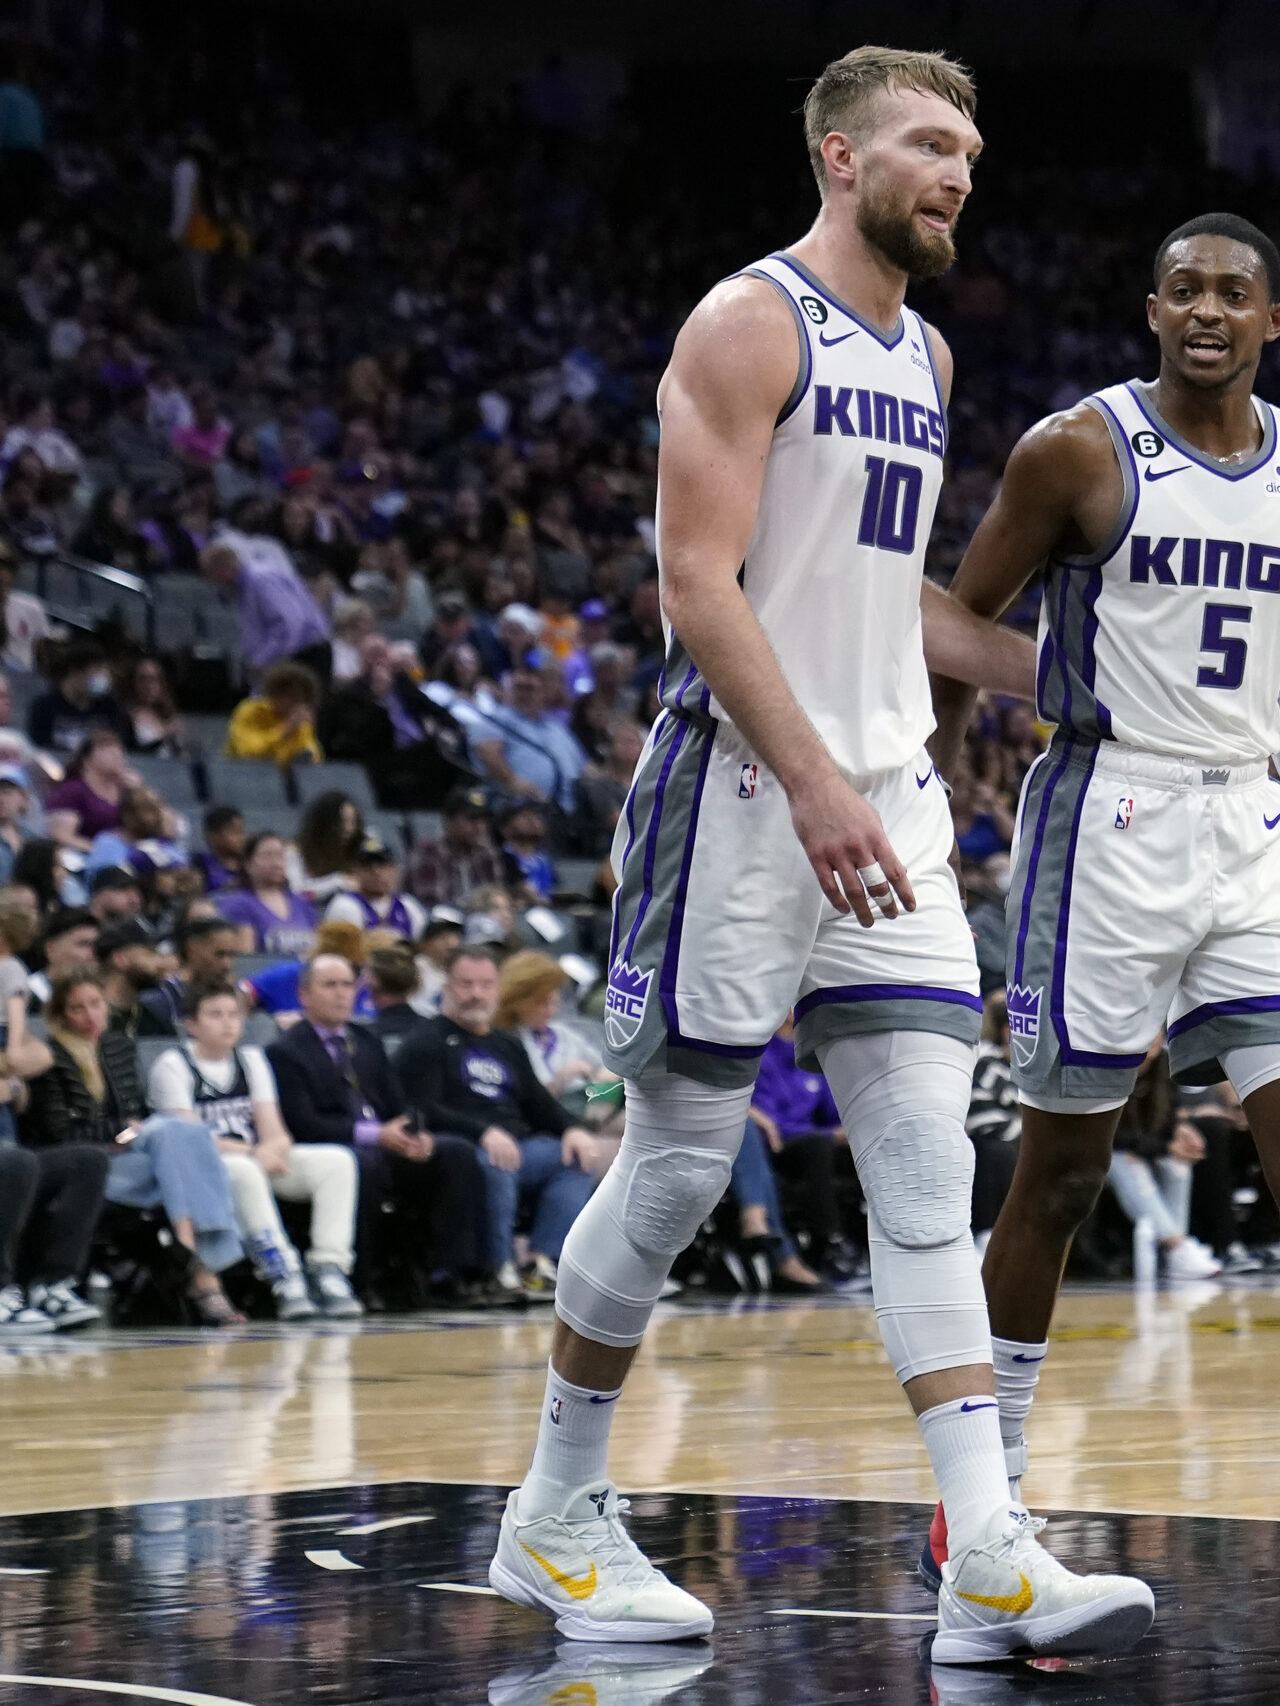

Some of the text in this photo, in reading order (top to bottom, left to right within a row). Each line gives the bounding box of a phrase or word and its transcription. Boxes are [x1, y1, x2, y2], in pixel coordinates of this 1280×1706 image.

[803, 299, 823, 322] 6
[813, 385, 945, 460] KINGS
[1138, 434, 1158, 455] 6
[857, 453, 923, 555] 10
[1196, 602, 1252, 690] 5
[606, 988, 644, 1019] SAC
